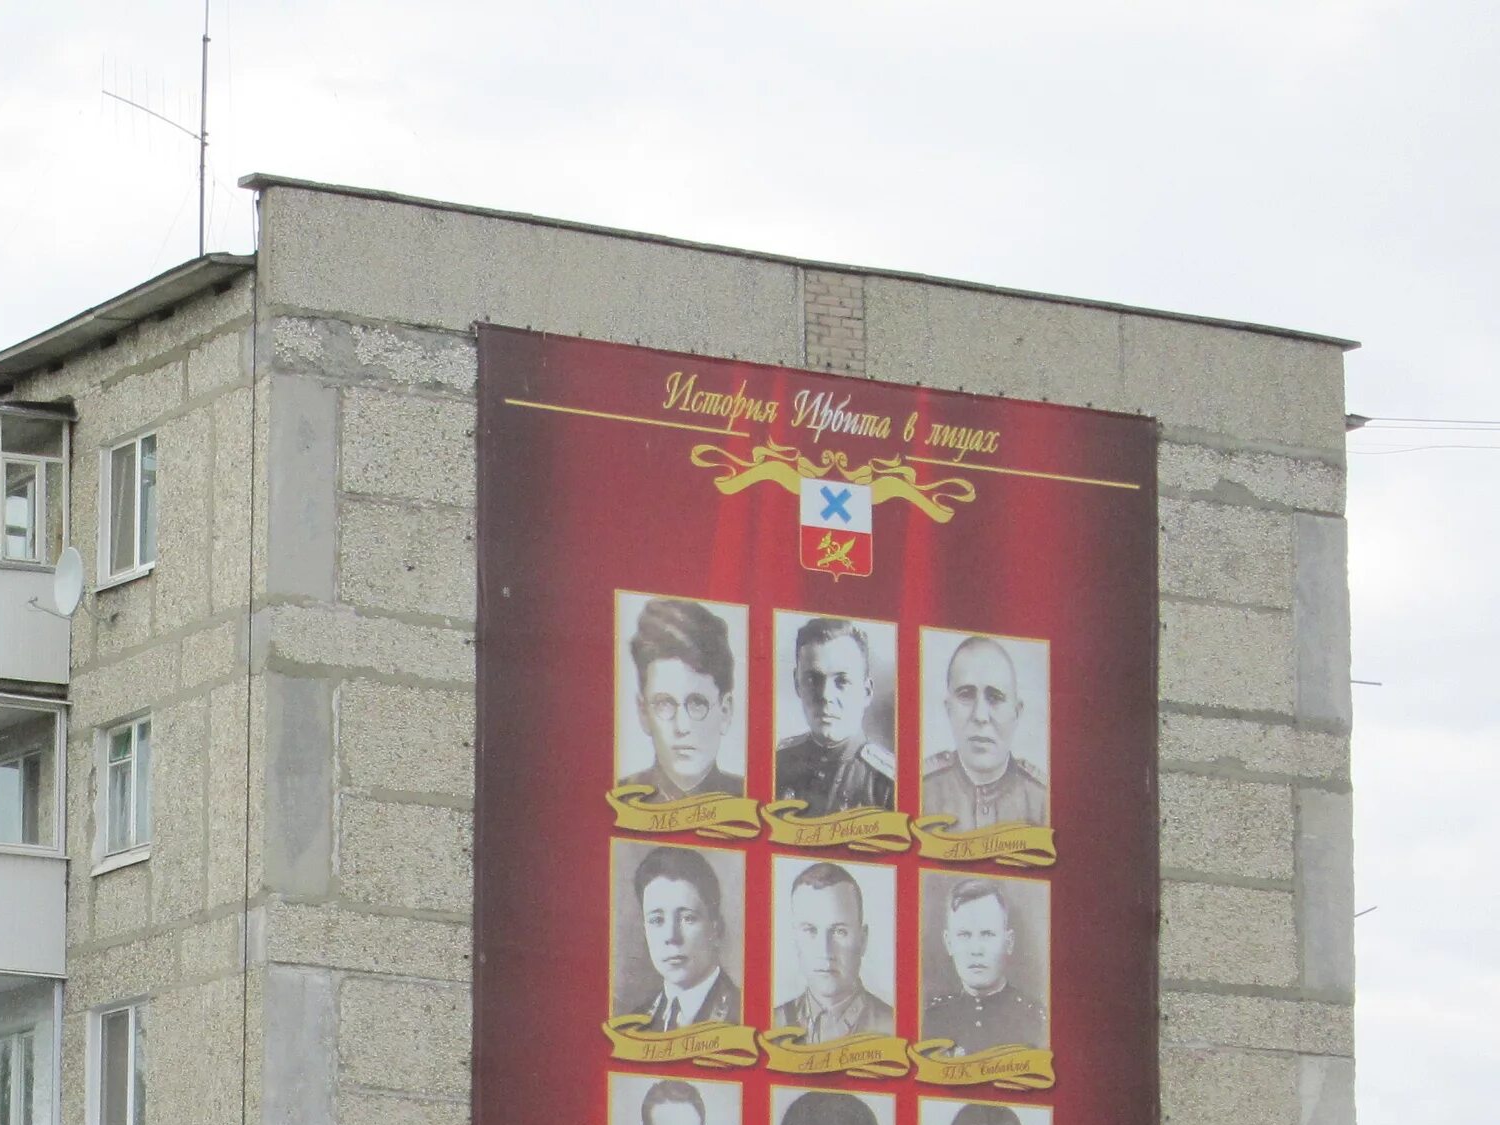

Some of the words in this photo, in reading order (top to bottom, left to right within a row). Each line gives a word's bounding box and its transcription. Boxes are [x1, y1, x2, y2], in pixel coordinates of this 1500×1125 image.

[663, 371, 779, 431] История
[791, 389, 892, 443] Ирбита
[903, 411, 918, 442] в
[925, 422, 1000, 462] лицах
